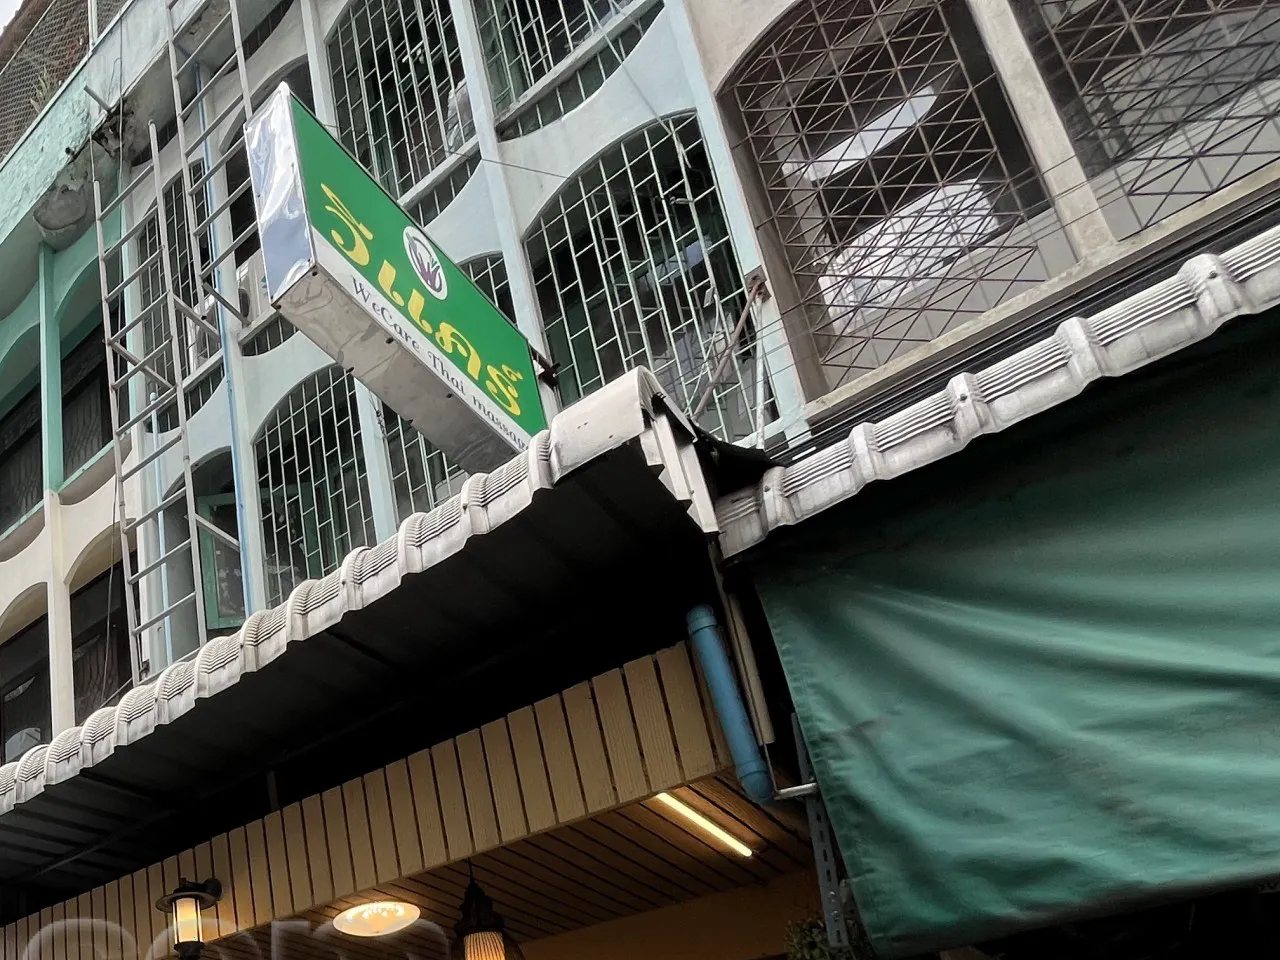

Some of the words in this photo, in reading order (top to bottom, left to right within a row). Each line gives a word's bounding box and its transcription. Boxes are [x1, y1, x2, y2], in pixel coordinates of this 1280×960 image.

[320, 182, 523, 417] วีแคร์
[427, 347, 467, 399] Thai
[471, 395, 529, 451] massag
